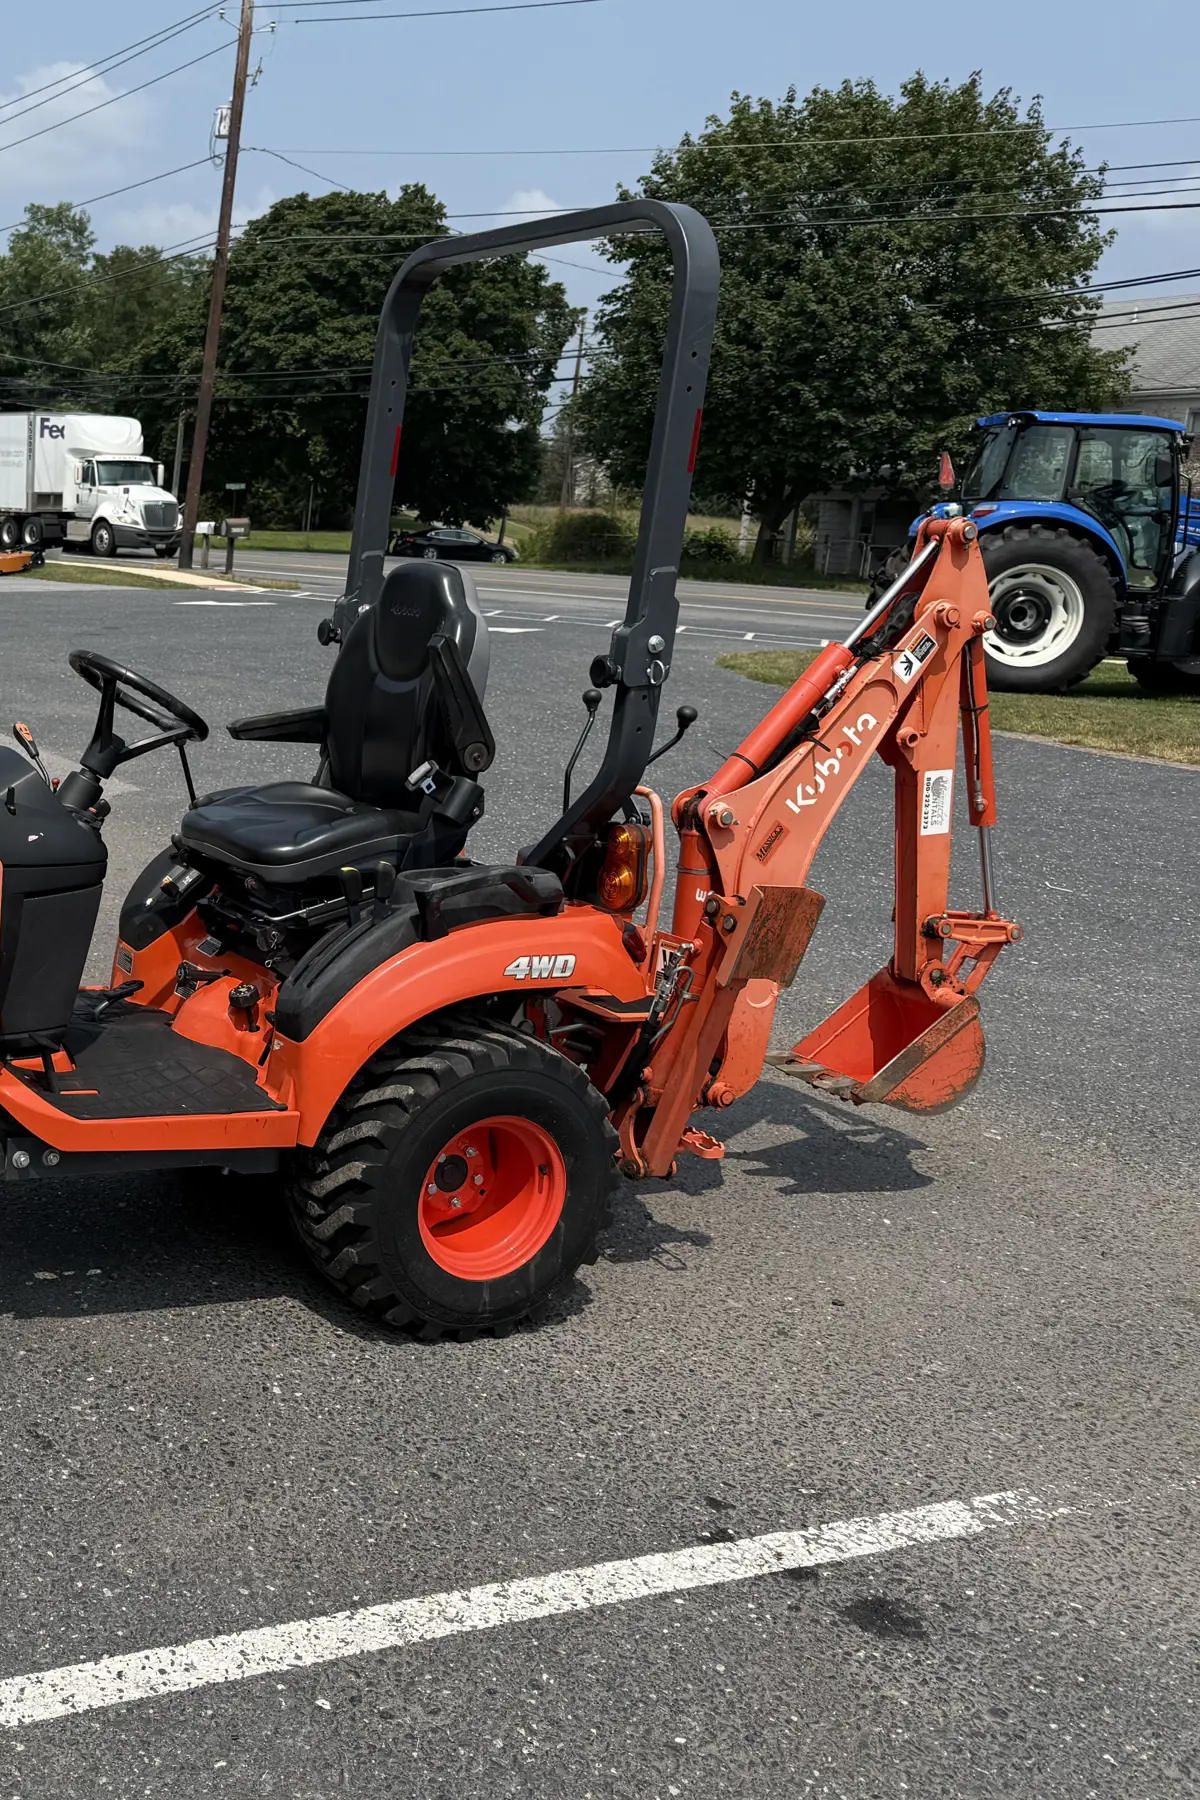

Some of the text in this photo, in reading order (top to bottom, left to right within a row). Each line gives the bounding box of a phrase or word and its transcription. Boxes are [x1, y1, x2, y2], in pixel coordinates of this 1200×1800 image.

[784, 712, 879, 815] Kubota
[922, 777, 932, 829] 800-222-3373
[503, 953, 577, 980] 4WD
